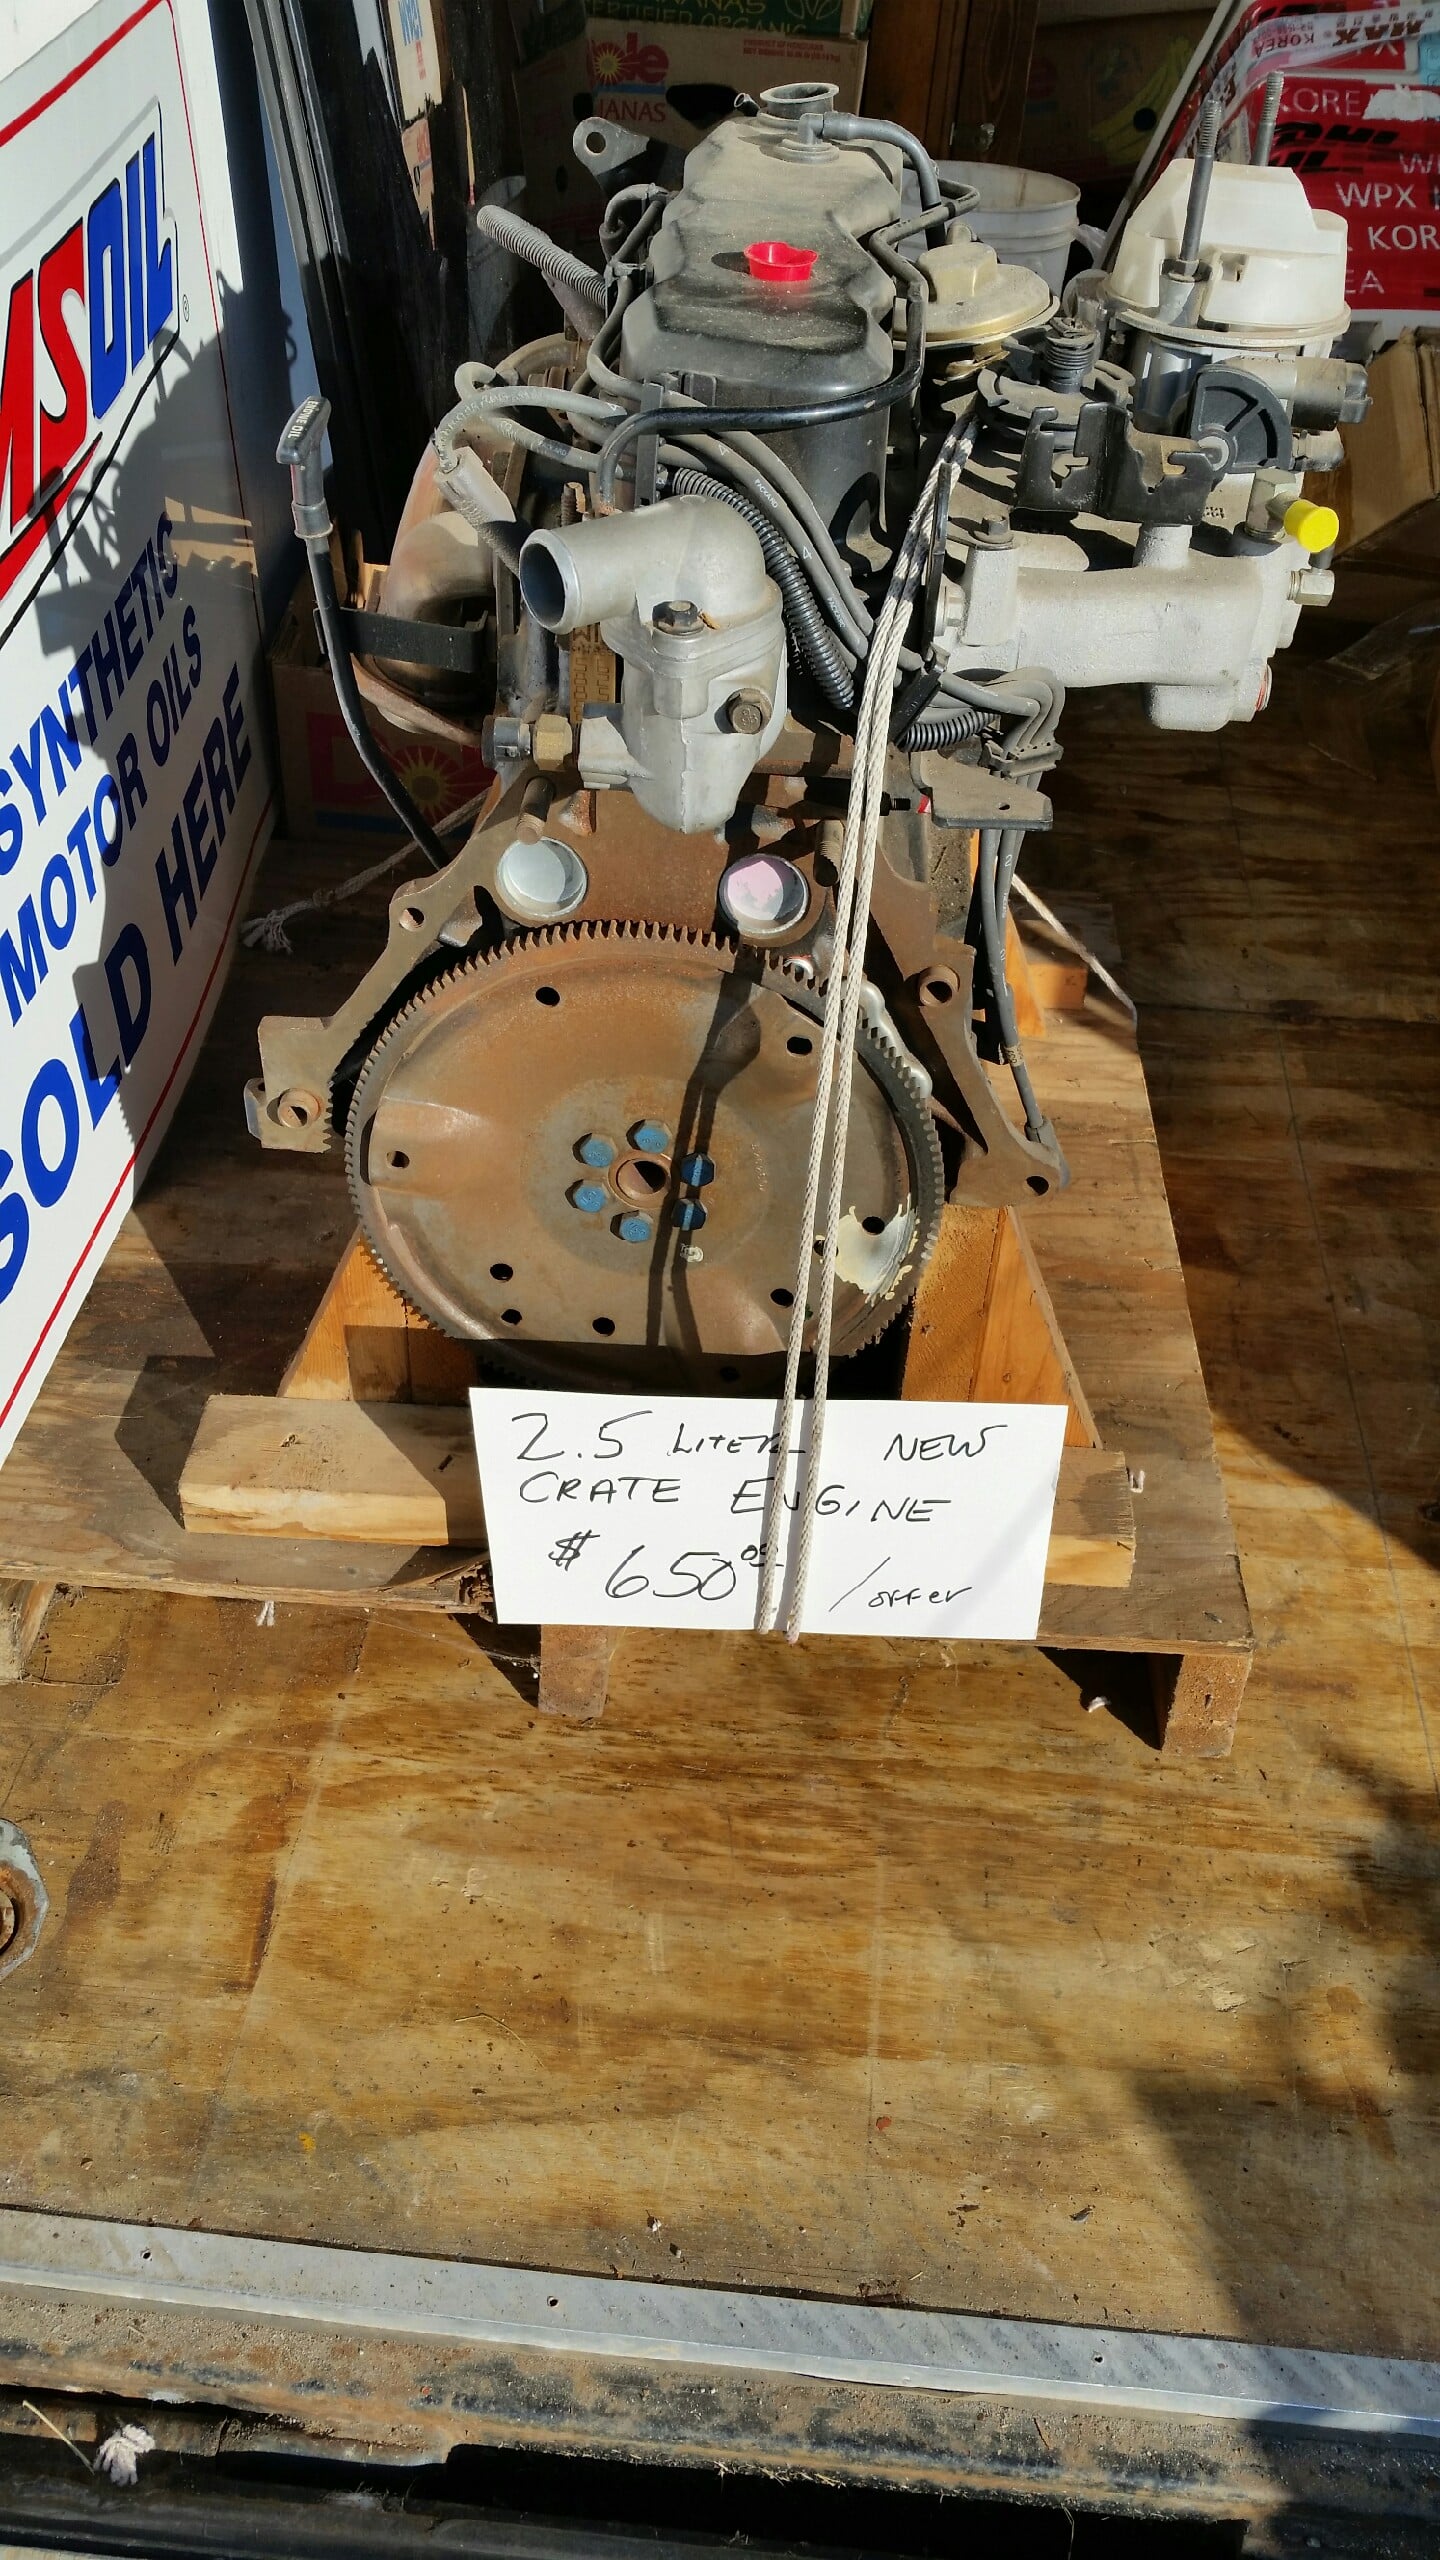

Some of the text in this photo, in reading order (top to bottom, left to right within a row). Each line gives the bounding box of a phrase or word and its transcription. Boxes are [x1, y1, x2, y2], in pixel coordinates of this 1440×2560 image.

[1254, 32, 1315, 58] KOREA
[1335, 181, 1416, 209] WPX
[287, 425, 304, 439] OIL
[0, 511, 178, 876] SYNTHETIC
[0, 605, 201, 1027] MOTOR OILS
[155, 661, 252, 966] HERE
[512, 1410, 653, 1461] 2.5
[883, 1424, 1008, 1461] NEW
[519, 1470, 952, 1522] CRATE ENGINE
